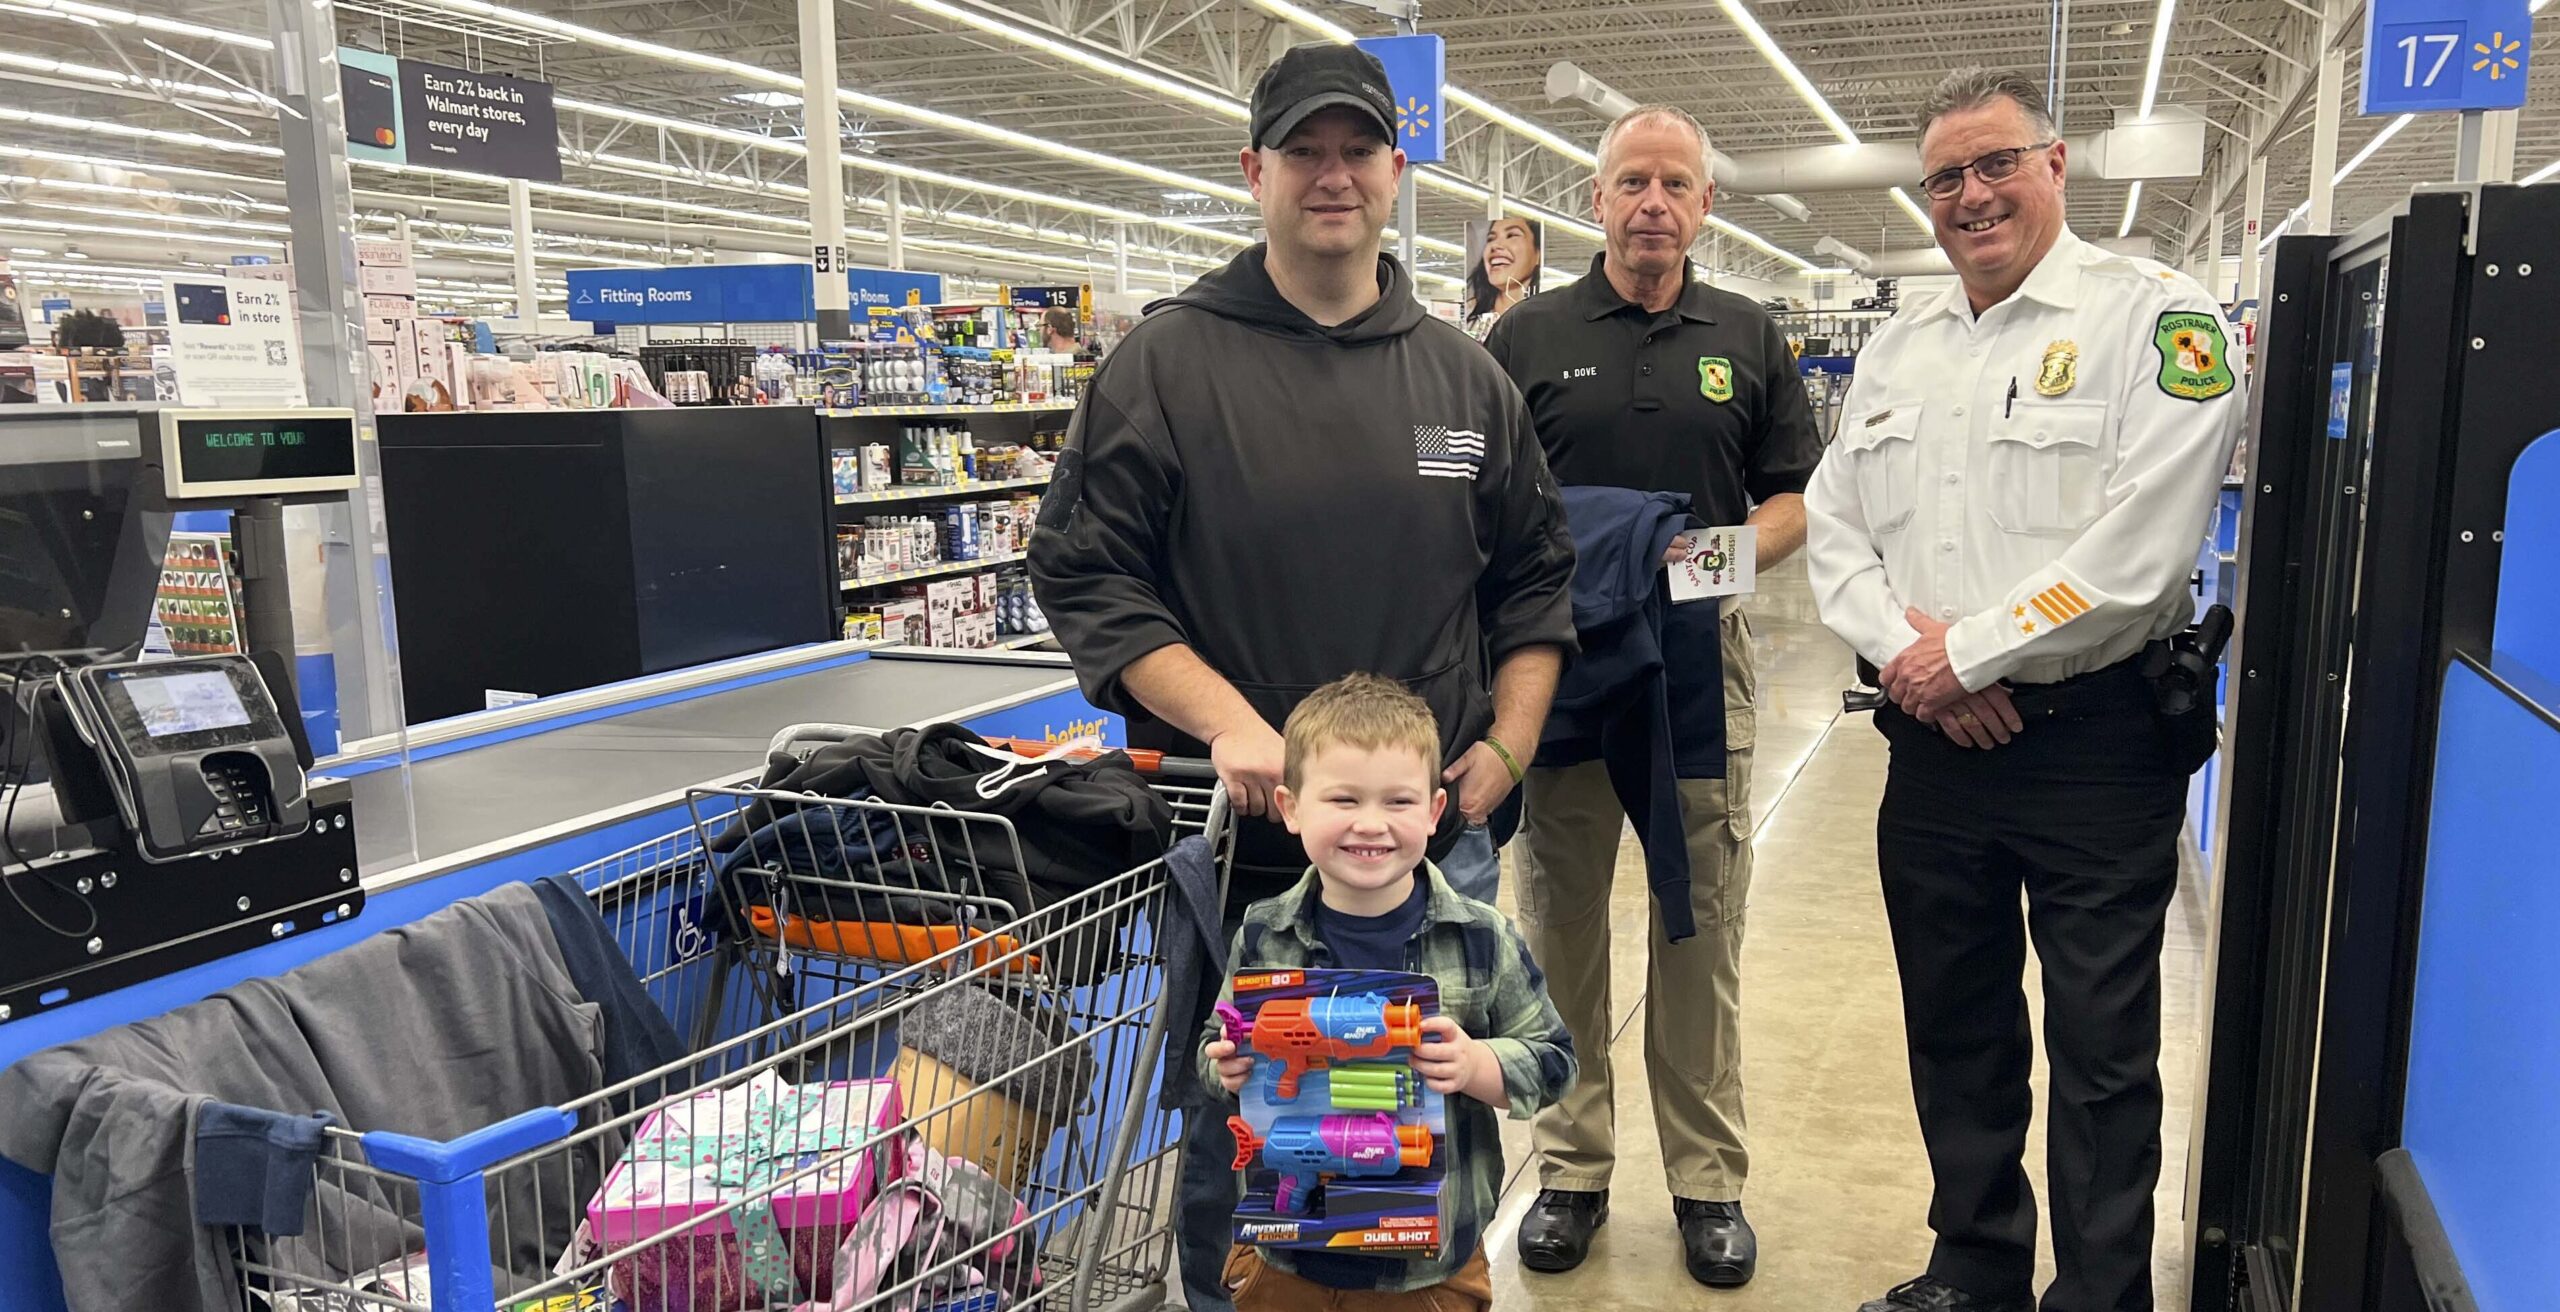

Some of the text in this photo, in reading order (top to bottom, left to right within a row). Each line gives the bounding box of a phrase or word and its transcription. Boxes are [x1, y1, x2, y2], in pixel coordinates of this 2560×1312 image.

[2398, 34, 2459, 88] 17
[424, 73, 524, 104] Earn 2% back in
[425, 94, 526, 126] Walmart stores,
[428, 119, 489, 143] every day
[236, 291, 280, 306] Earn 2%
[600, 287, 692, 307] Fitting Rooms
[860, 288, 890, 304] Rooms
[369, 301, 410, 310] FLAWLESS
[238, 309, 280, 323] in store
[2161, 318, 2217, 333] ROSTRAVER
[1563, 367, 1597, 379] B. DOVE
[2180, 376, 2217, 386] POLICE
[206, 431, 306, 447] WELCOME TO YOUR
[1686, 536, 1701, 587] SANTA COP
[1728, 567, 1736, 583] AND
[1343, 1032, 1367, 1040] SHOT
[1355, 1026, 1377, 1034] DUEL
[1364, 1146, 1386, 1155] DUEL
[1240, 1223, 1300, 1237] ADVENTURE
[1363, 1230, 1432, 1243] DUEL SHOT
